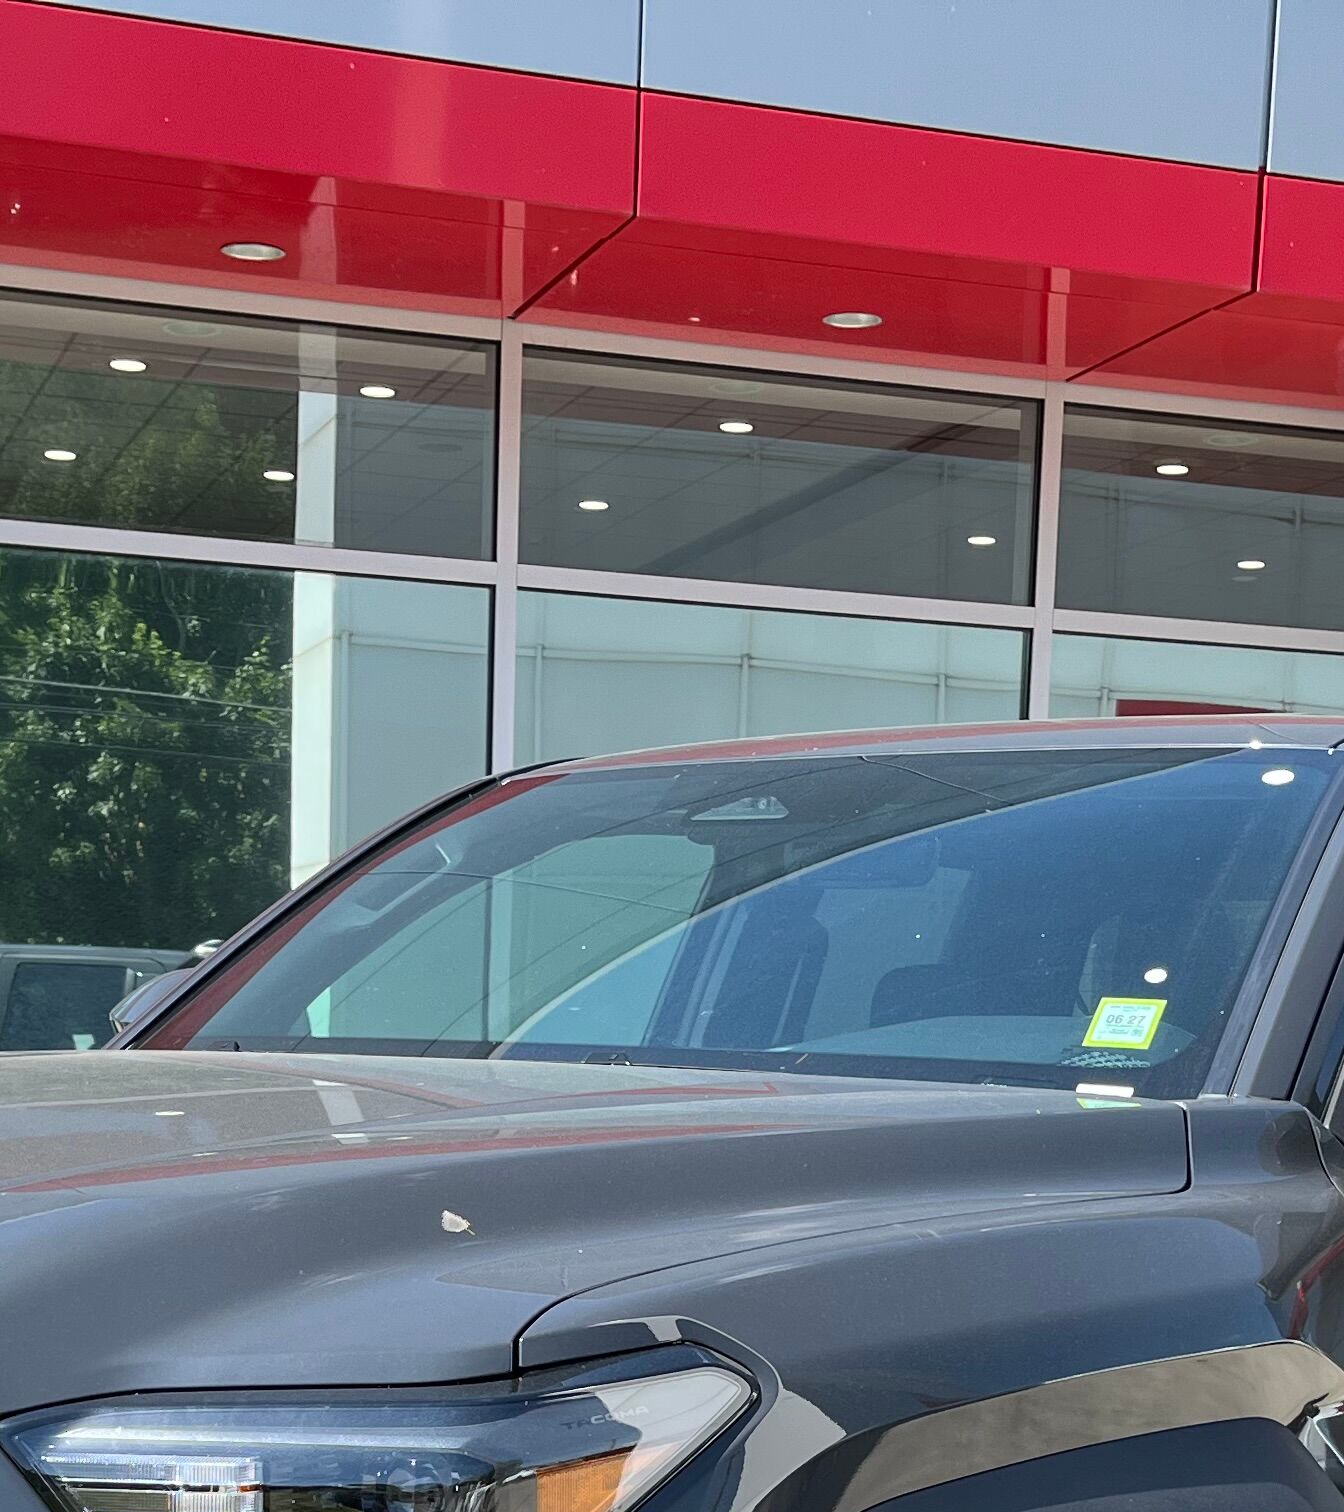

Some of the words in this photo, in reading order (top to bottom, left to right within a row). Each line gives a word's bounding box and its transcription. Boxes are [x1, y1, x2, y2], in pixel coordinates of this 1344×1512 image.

[1105, 1014, 1125, 1024] 06
[1127, 1015, 1146, 1025] 27
[560, 1406, 649, 1429] TACOMA
